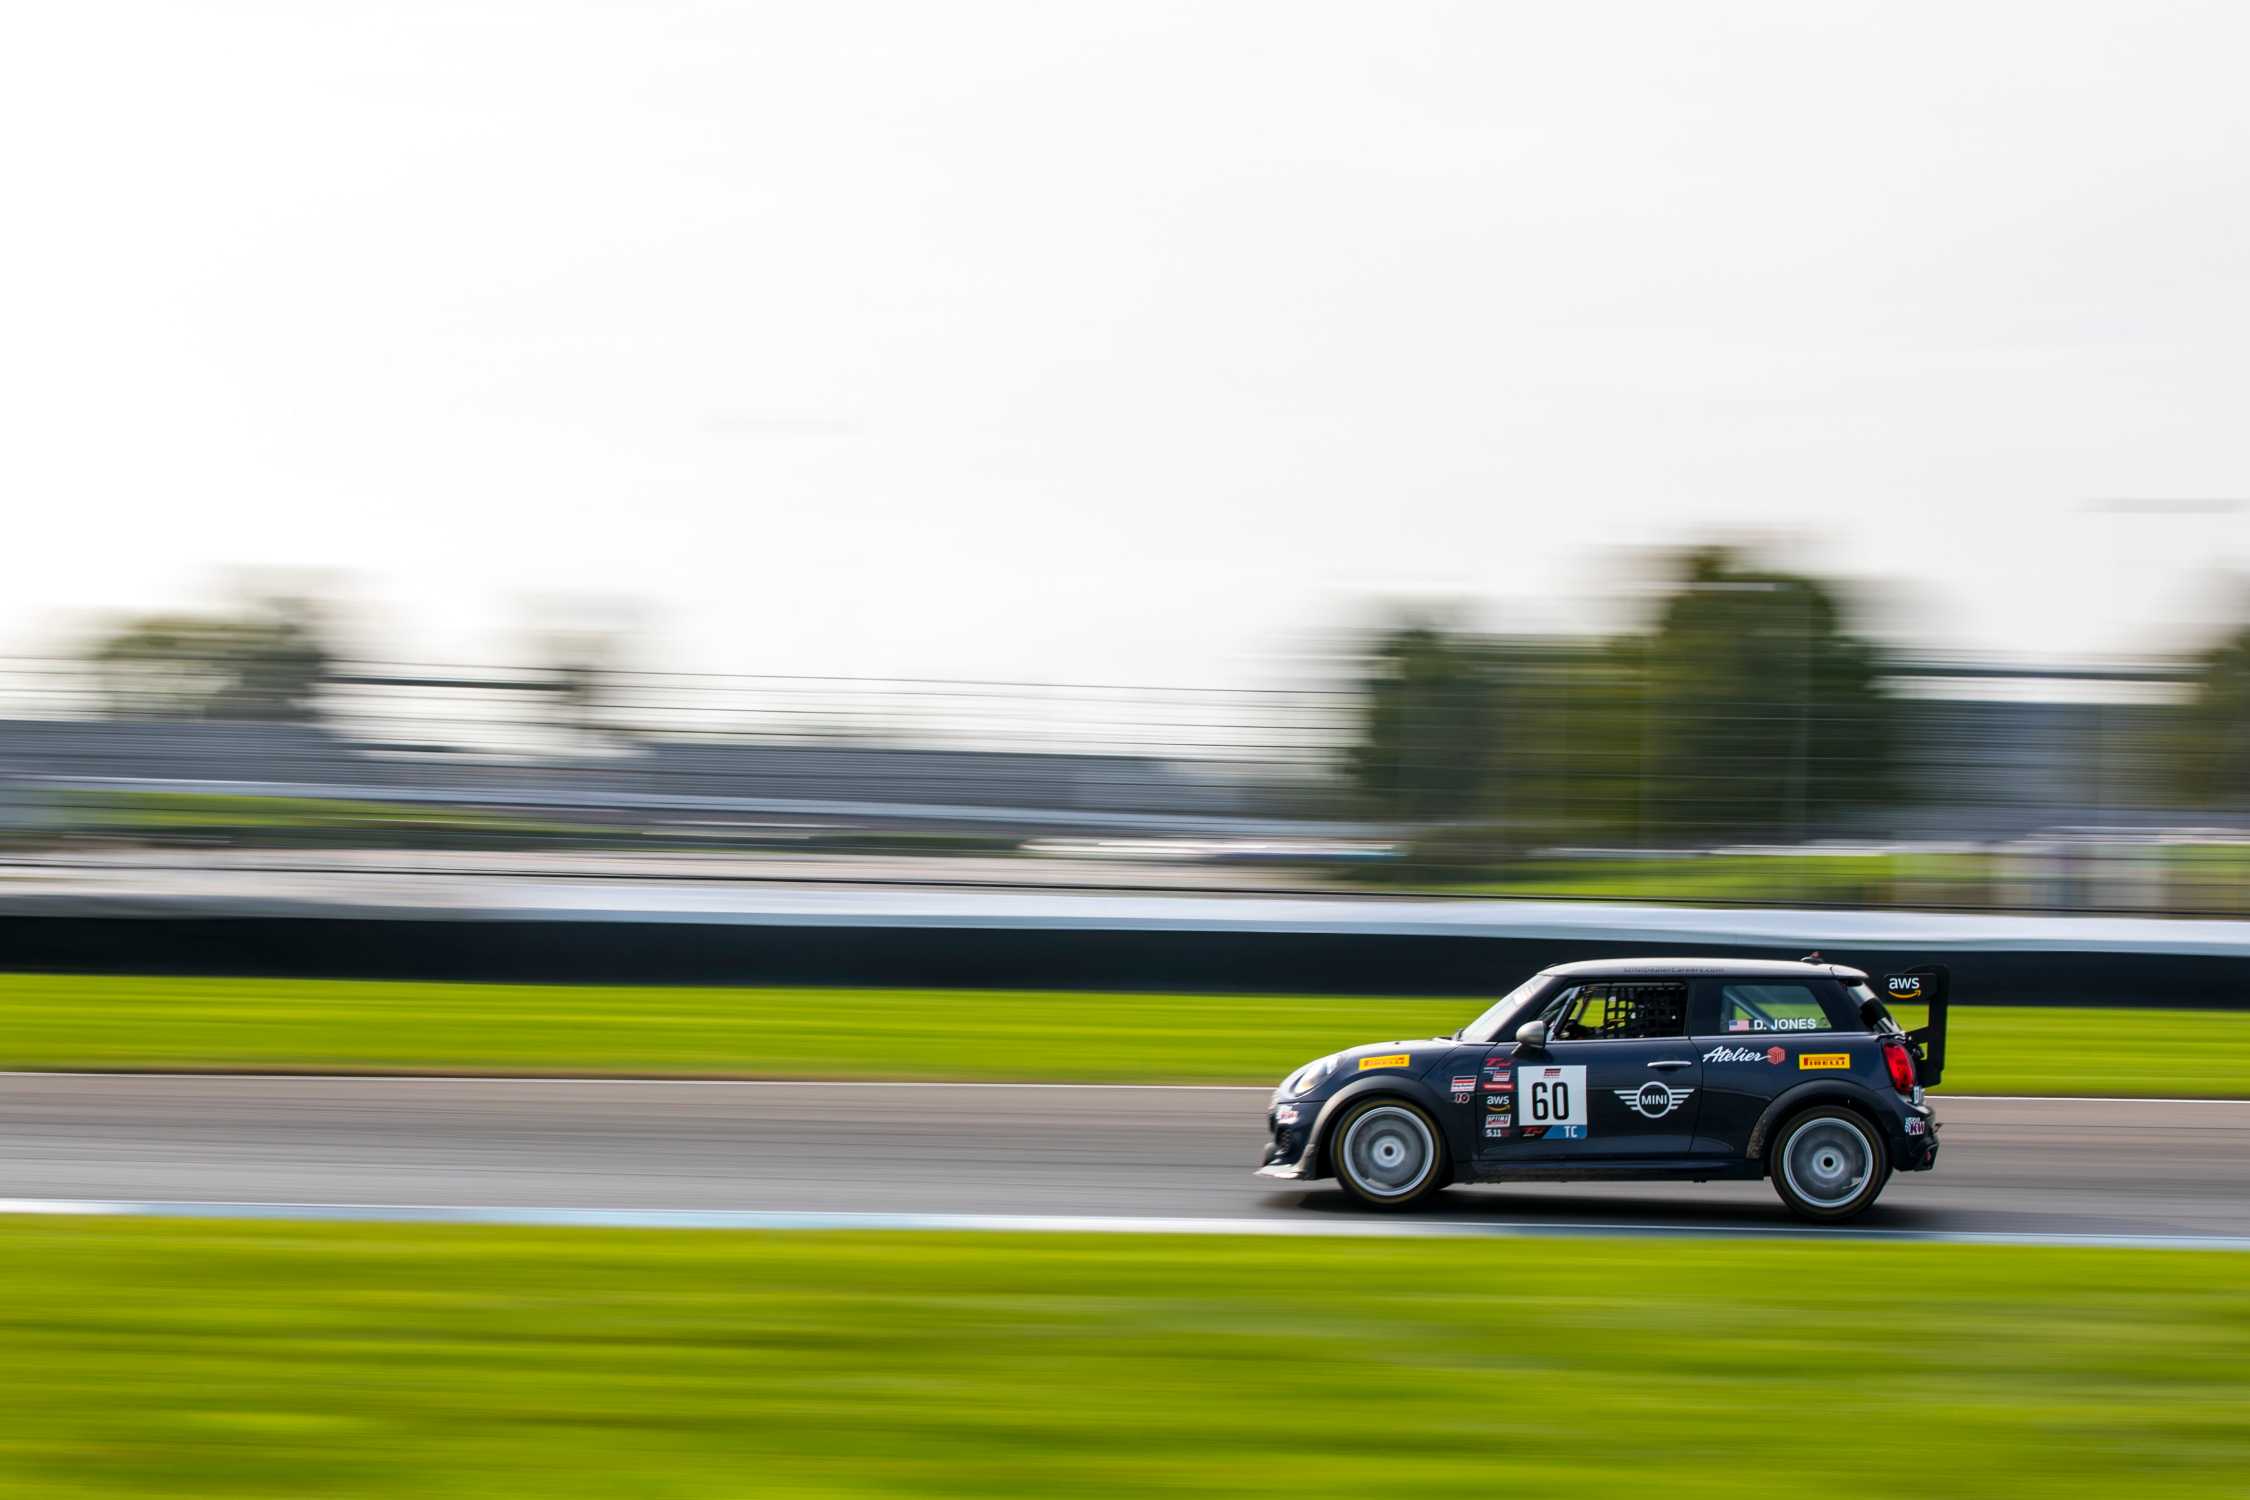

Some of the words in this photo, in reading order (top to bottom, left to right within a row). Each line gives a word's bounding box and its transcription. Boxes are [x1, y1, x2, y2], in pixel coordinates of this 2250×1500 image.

[1888, 977, 1920, 989] aws
[1753, 1019, 1767, 1030] D.
[1770, 1018, 1817, 1030] JONES
[1702, 1045, 1768, 1063] Atelier
[1487, 1095, 1510, 1105] aws
[1531, 1081, 1570, 1120] 60
[1641, 1094, 1668, 1105] MINI
[1564, 1126, 1578, 1138] TC
